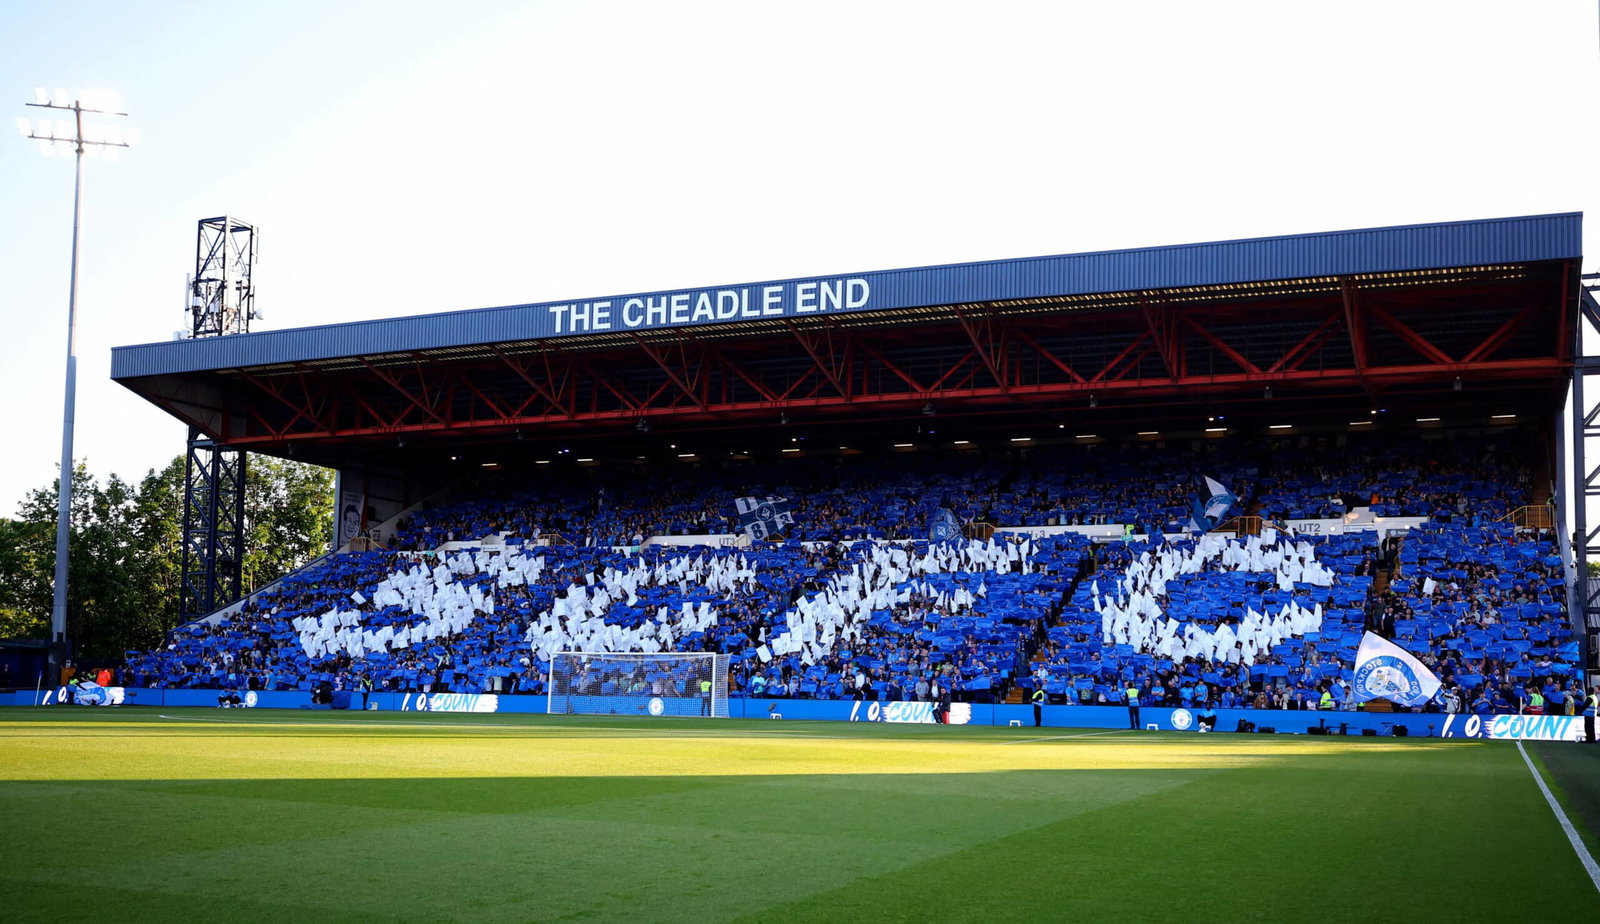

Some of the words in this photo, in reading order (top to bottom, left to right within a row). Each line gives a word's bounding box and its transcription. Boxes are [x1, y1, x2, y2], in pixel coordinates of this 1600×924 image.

[549, 301, 611, 333] THE
[622, 286, 784, 329] CHEADLE
[796, 278, 870, 313] END
[1299, 523, 1321, 533] UT2
[719, 537, 735, 547] UT3
